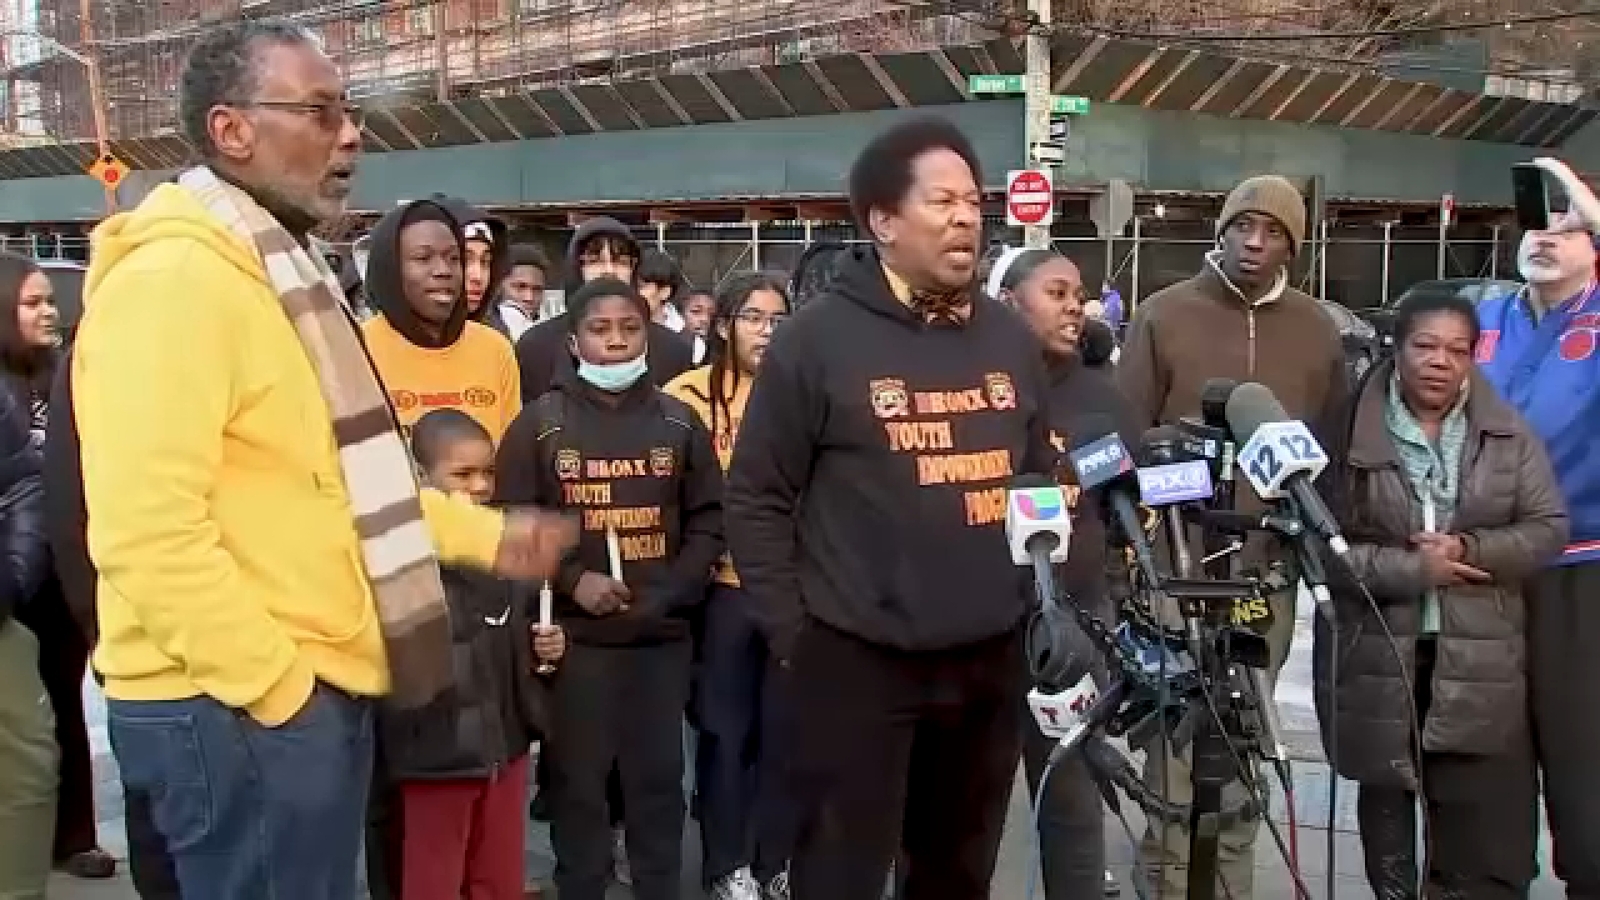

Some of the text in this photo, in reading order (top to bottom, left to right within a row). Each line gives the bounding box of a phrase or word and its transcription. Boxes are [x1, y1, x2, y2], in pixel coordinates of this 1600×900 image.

[885, 421, 953, 450] YOUTH
[1279, 434, 1320, 460] 12
[1249, 444, 1284, 487] 12
[564, 482, 612, 503] YOUTH
